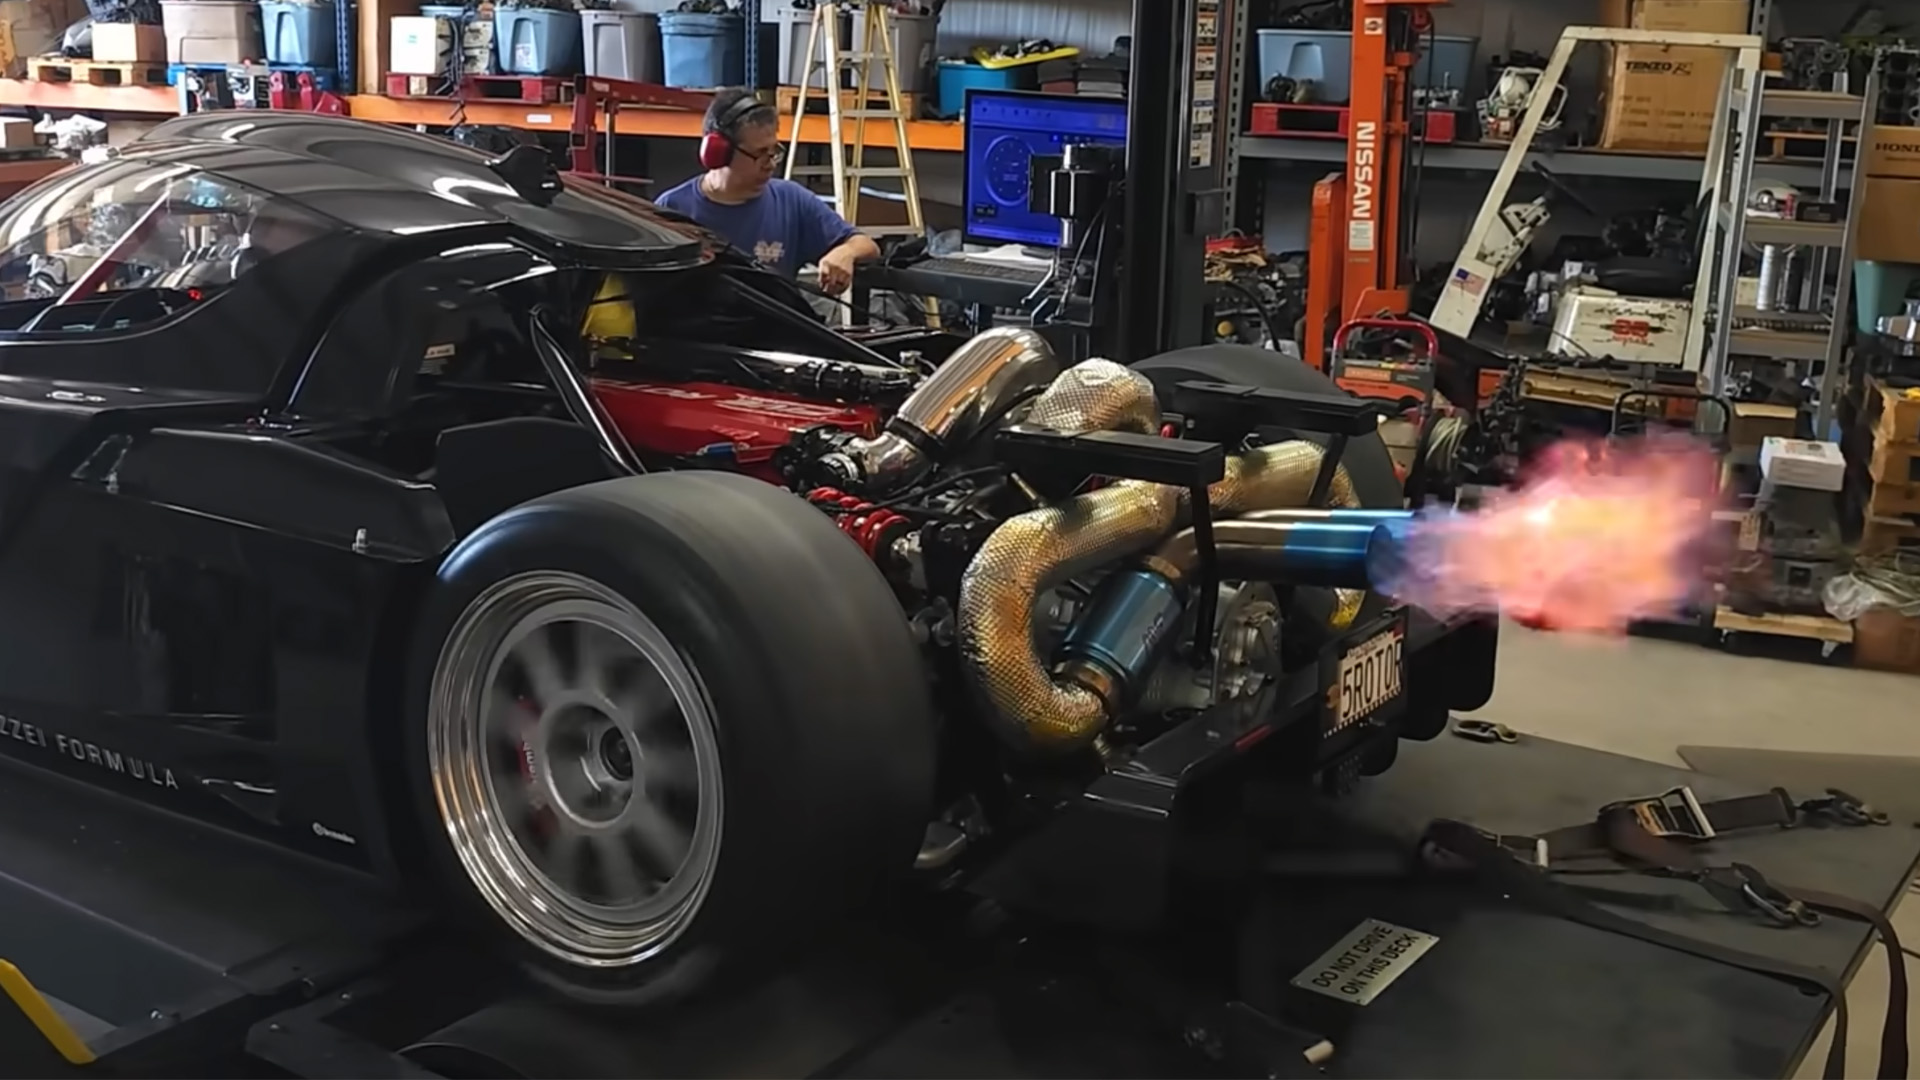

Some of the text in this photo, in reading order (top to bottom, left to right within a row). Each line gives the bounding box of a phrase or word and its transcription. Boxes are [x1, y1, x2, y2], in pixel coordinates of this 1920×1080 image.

[1352, 121, 1376, 219] NISSAN
[55, 733, 179, 790] FORMULA
[1312, 925, 1393, 988] DO NOT DRIVE
[1340, 933, 1421, 995] ON THIS DECK
